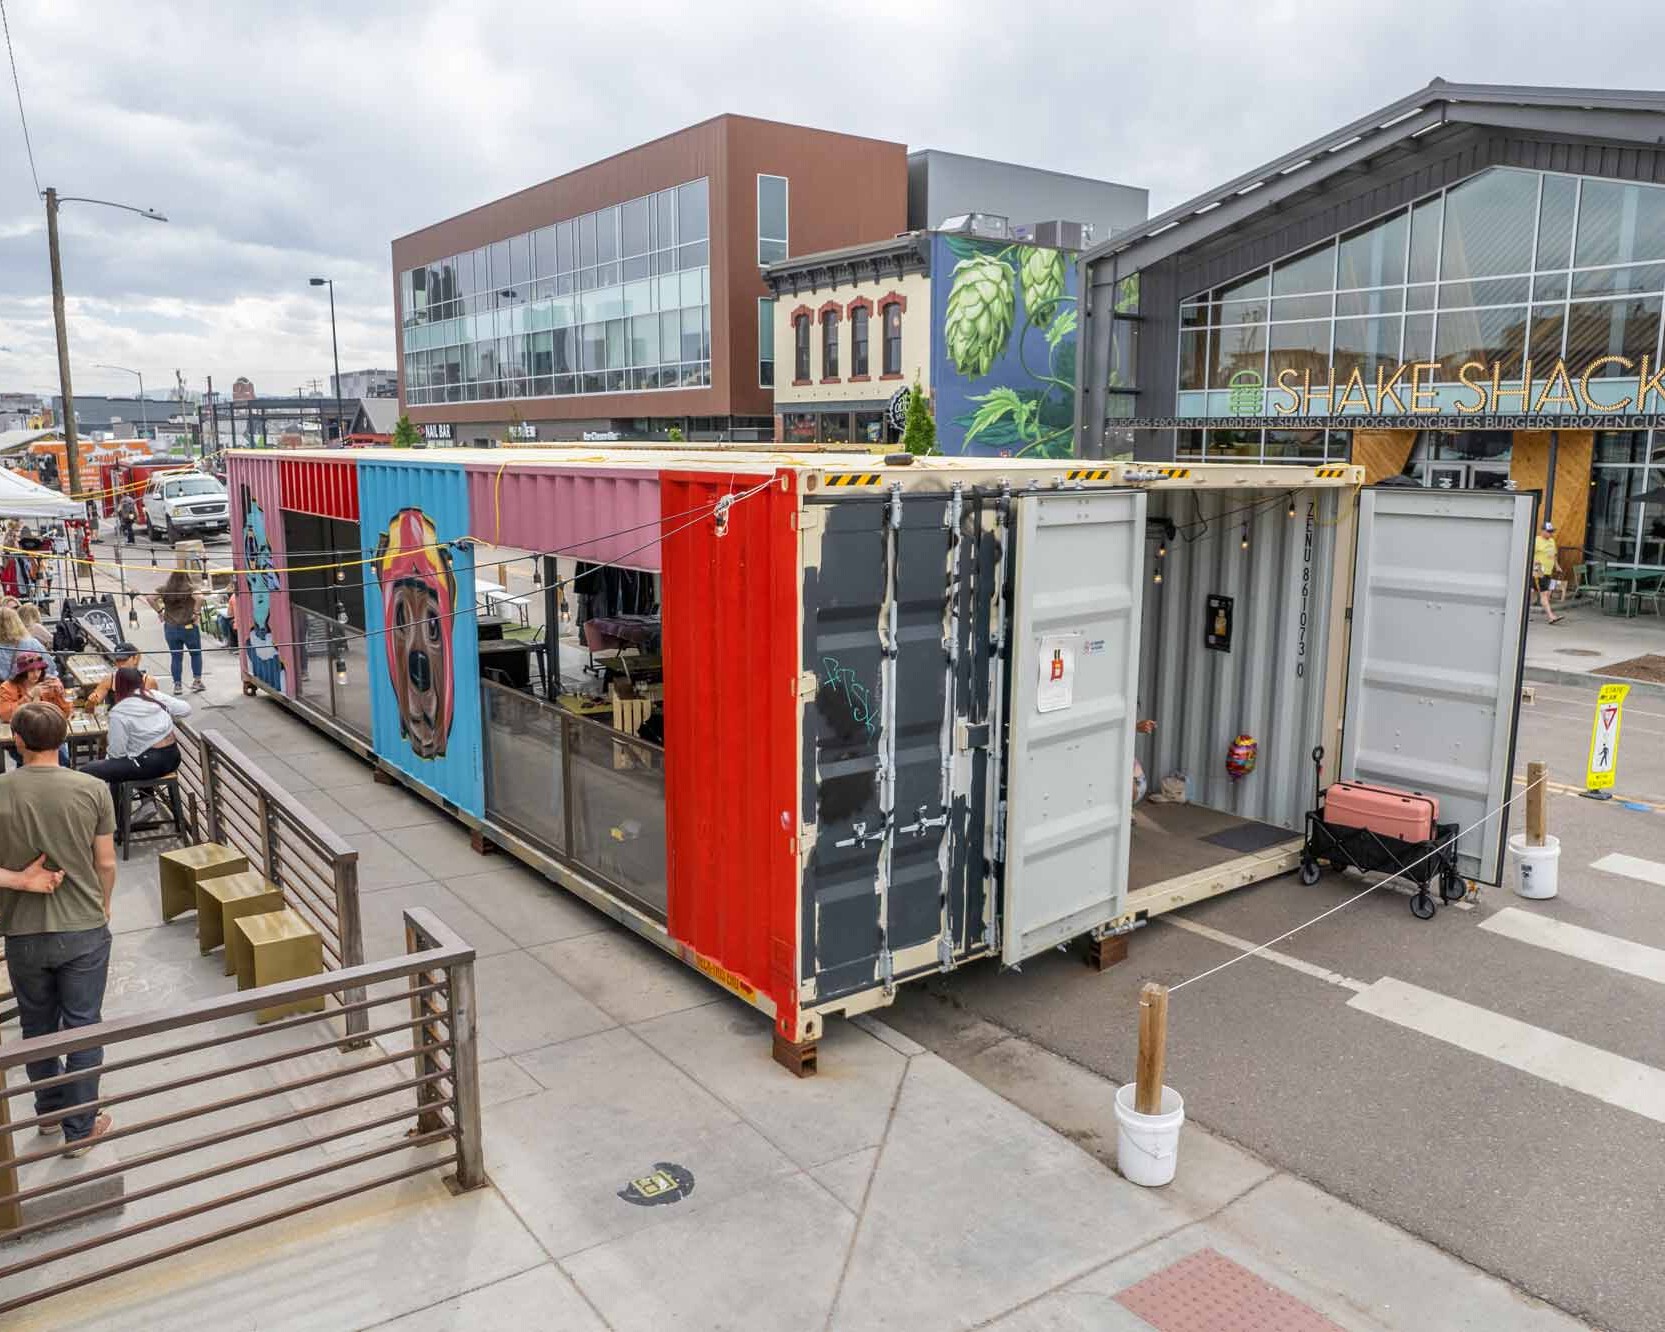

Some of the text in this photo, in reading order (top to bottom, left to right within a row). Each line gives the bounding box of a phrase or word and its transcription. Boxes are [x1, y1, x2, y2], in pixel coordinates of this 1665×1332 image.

[1274, 354, 1665, 416] SHAKE SHACK
[425, 423, 450, 439] NAIL BAR
[1196, 416, 1243, 428] CUSTARD
[1244, 417, 1274, 428] FRIES
[1278, 417, 1322, 428] SHAKES
[1328, 417, 1353, 428] HOT
[1355, 416, 1392, 428] DOGS
[1397, 416, 1481, 429] CONCRETES
[1486, 416, 1554, 429] BURGERS
[1560, 416, 1627, 429] FROZEN
[1297, 502, 1314, 678] ZENU 861073 0
